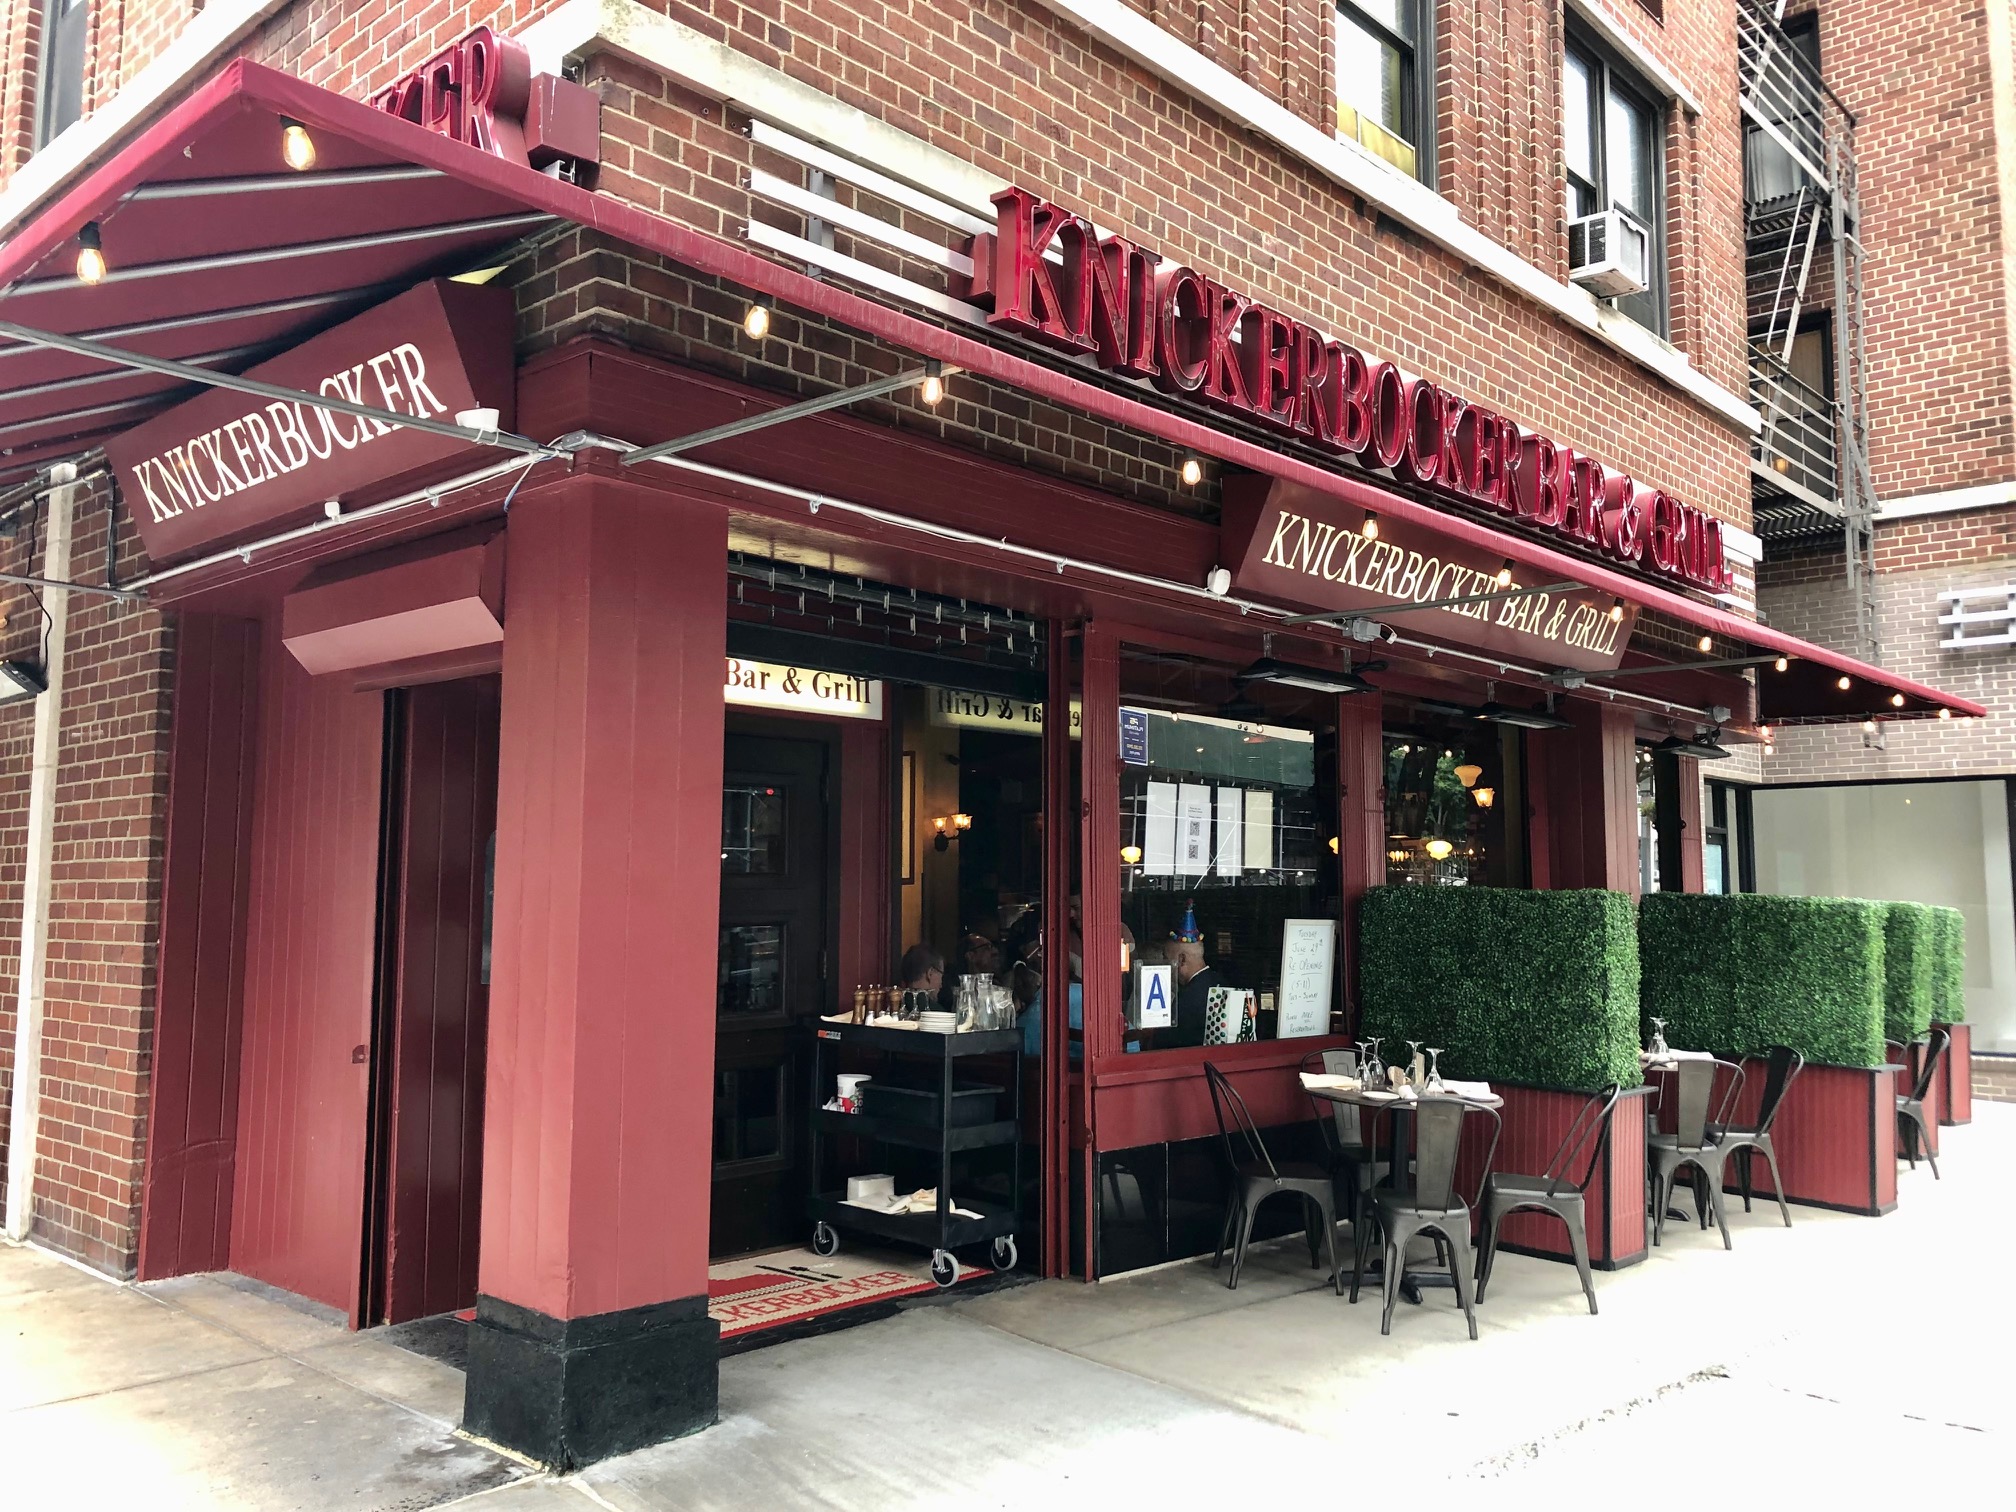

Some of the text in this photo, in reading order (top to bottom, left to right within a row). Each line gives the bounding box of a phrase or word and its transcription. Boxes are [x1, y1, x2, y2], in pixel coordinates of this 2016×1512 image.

[132, 342, 448, 524] KNICKERBOCKER
[987, 186, 1734, 595] KNICKERBOCKER BAR & GRILL
[1261, 510, 1623, 656] KNICKERBOCKER BAR & GRILL
[724, 657, 872, 705] Bar & Grill
[1146, 973, 1166, 1010] A
